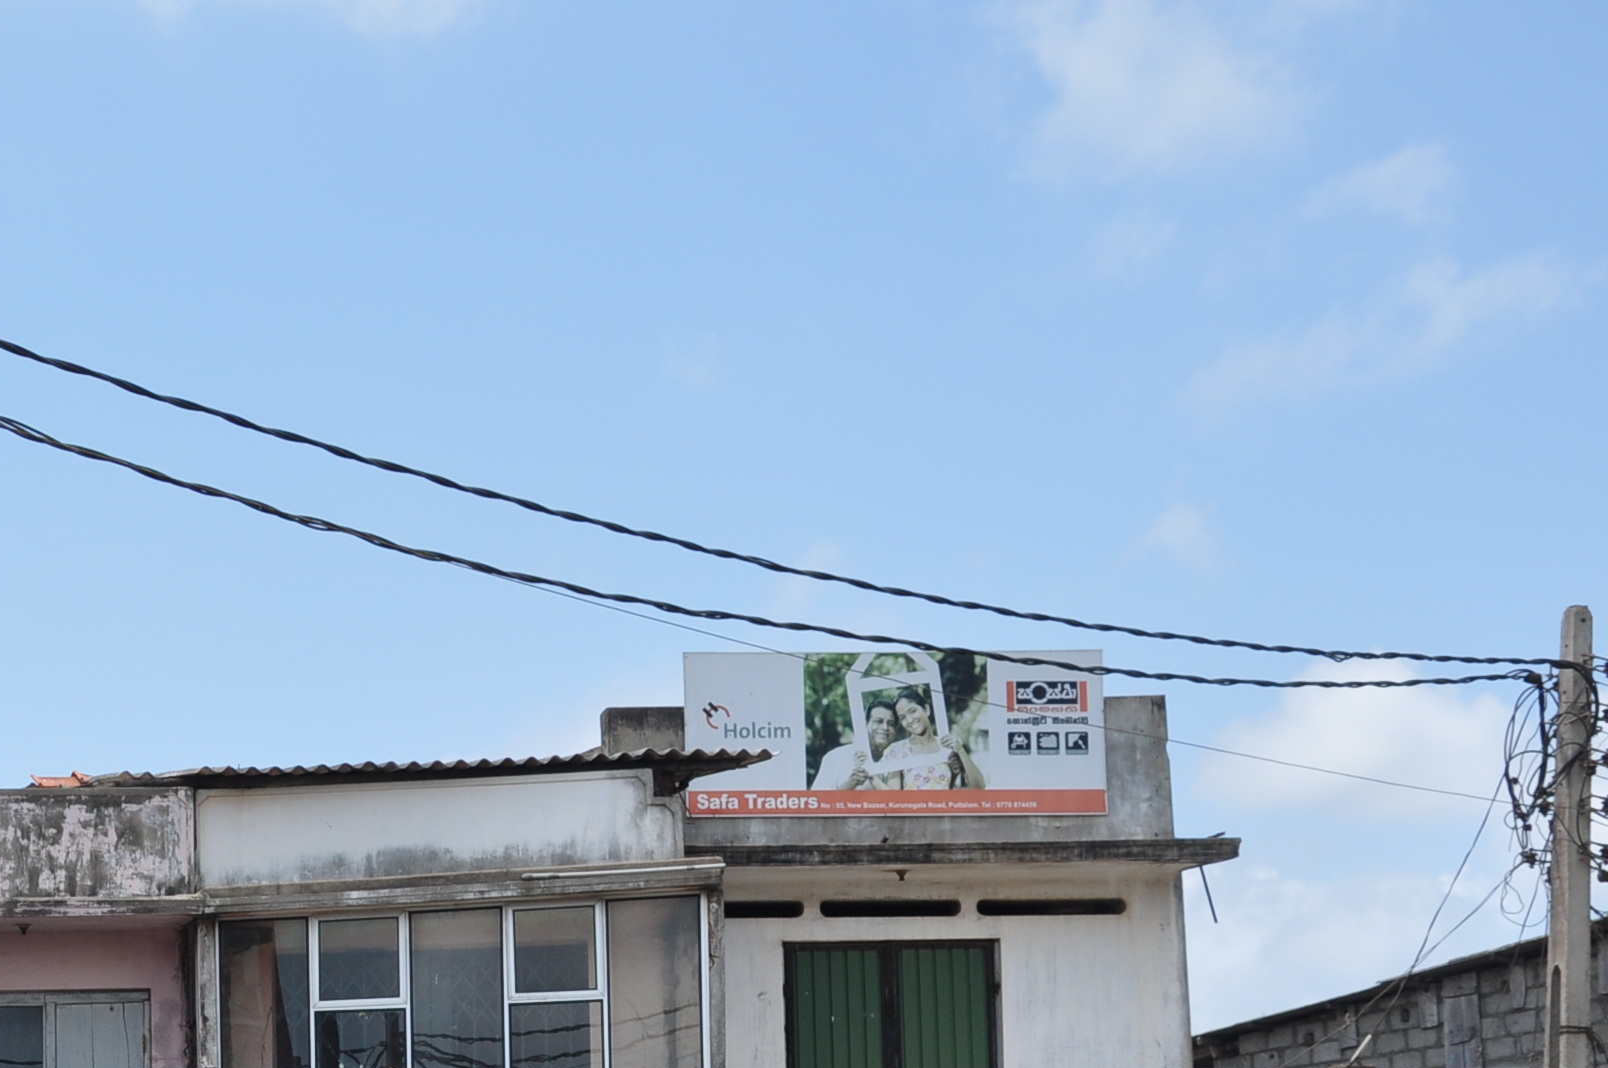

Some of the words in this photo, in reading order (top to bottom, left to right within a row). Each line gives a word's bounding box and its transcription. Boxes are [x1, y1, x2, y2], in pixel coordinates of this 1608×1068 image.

[724, 721, 791, 740] Holcim
[696, 794, 740, 811] Safa
[744, 793, 819, 810] Traders
